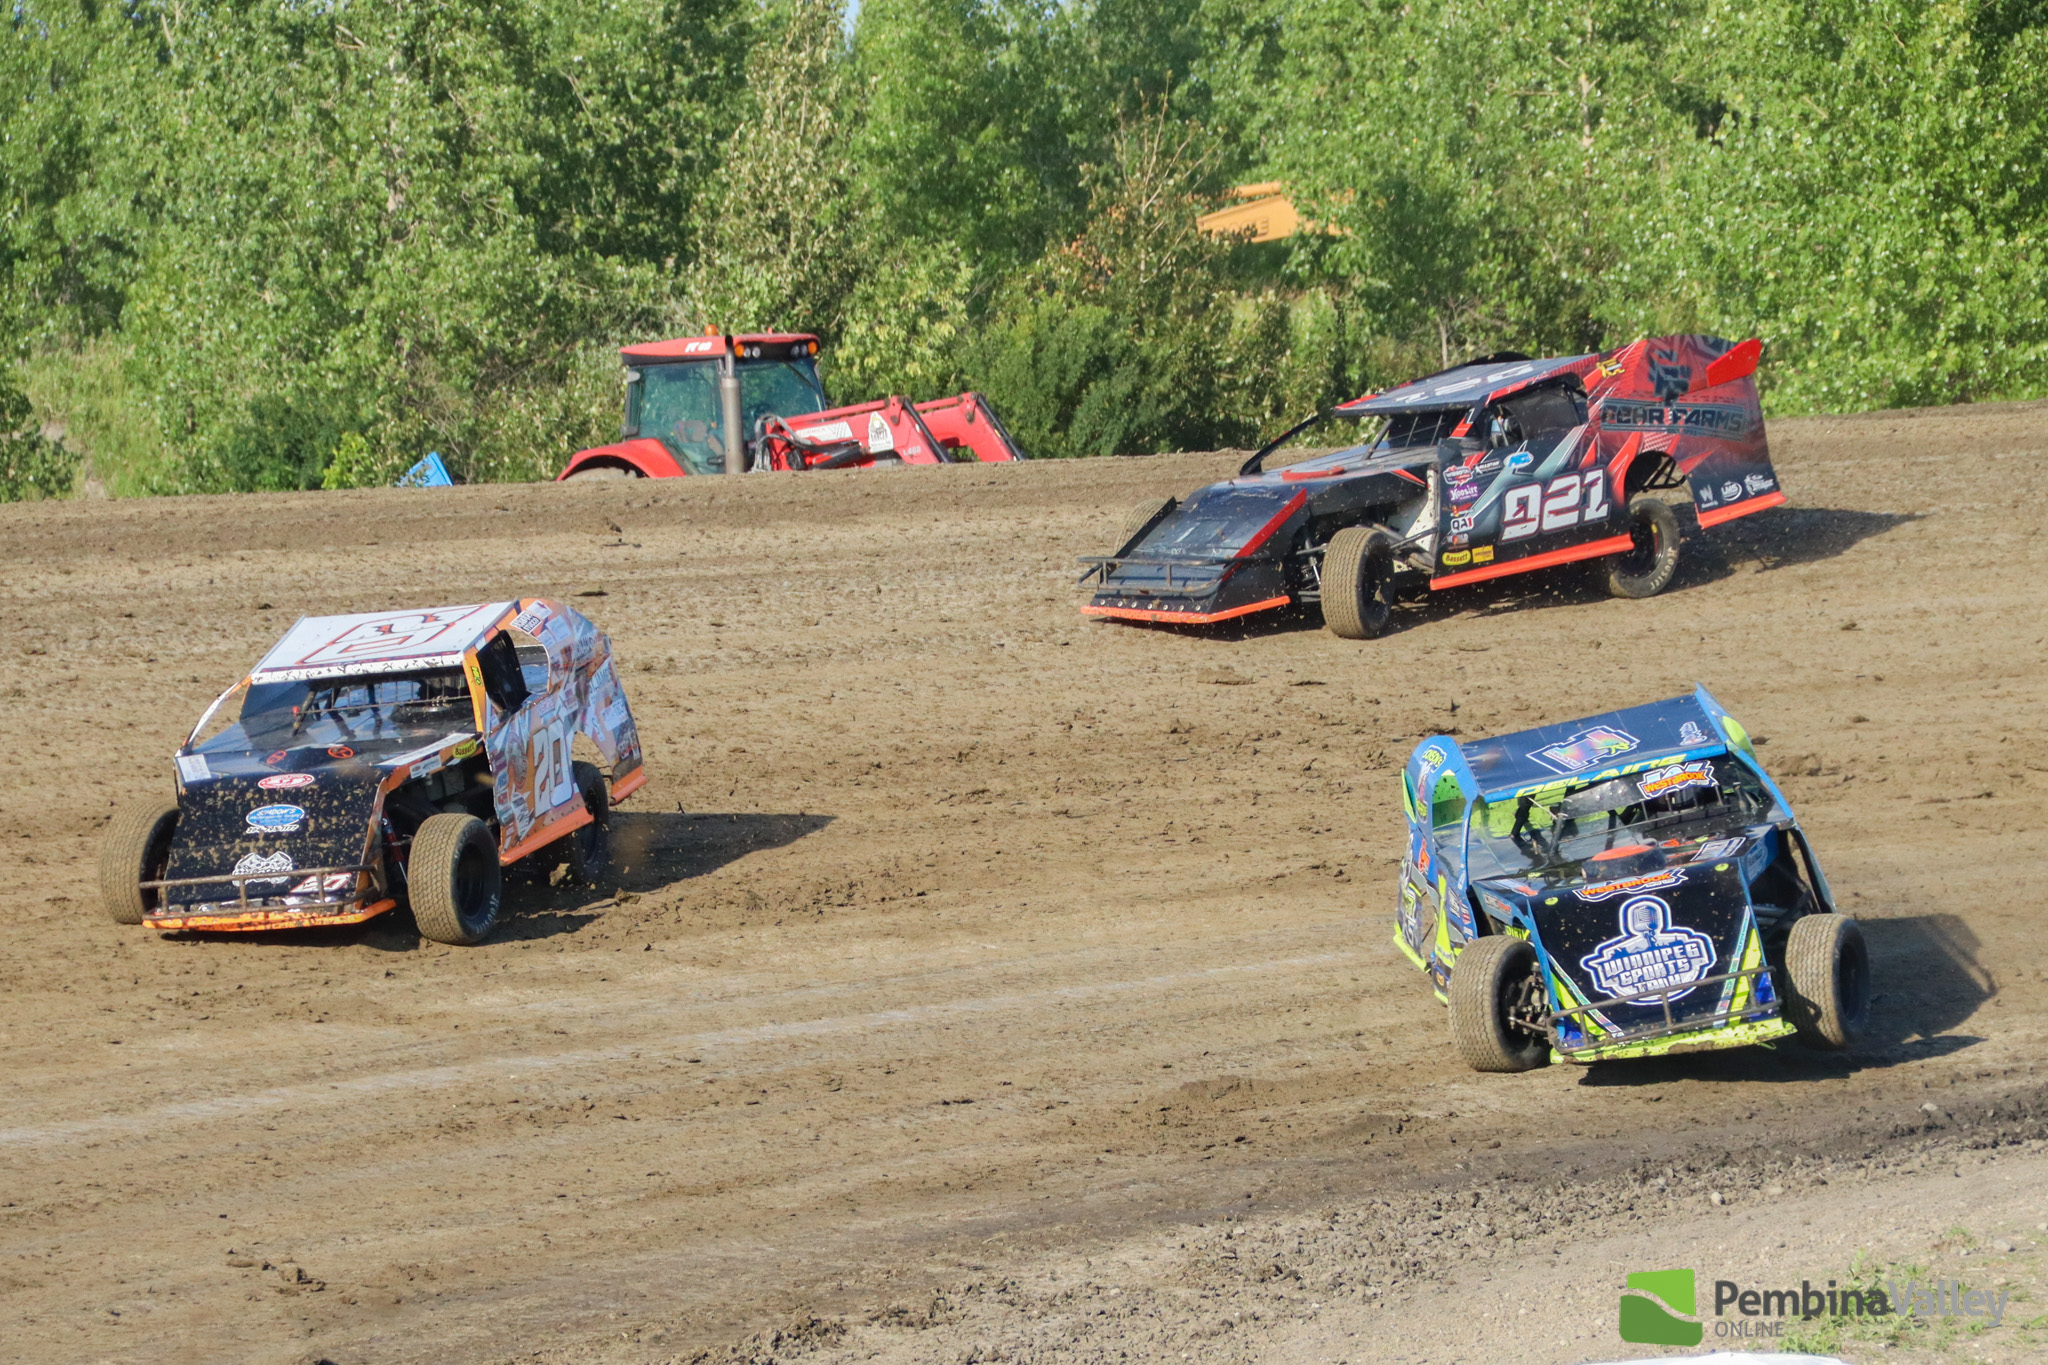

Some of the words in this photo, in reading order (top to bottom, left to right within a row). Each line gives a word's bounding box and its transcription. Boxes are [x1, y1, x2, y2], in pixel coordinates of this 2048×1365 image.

[1672, 407, 1745, 433] FARMS
[1501, 468, 1609, 541] 921
[1452, 517, 1473, 531] QA1
[1445, 552, 1469, 564] Bassett
[532, 717, 574, 818] 20
[1514, 753, 1688, 798] DELAIRE
[1644, 771, 1707, 794] WESTBROOK
[1581, 872, 1672, 896] WESTBROOK
[1604, 943, 1701, 977] WINNIPEG
[1619, 959, 1691, 987] SPORTS
